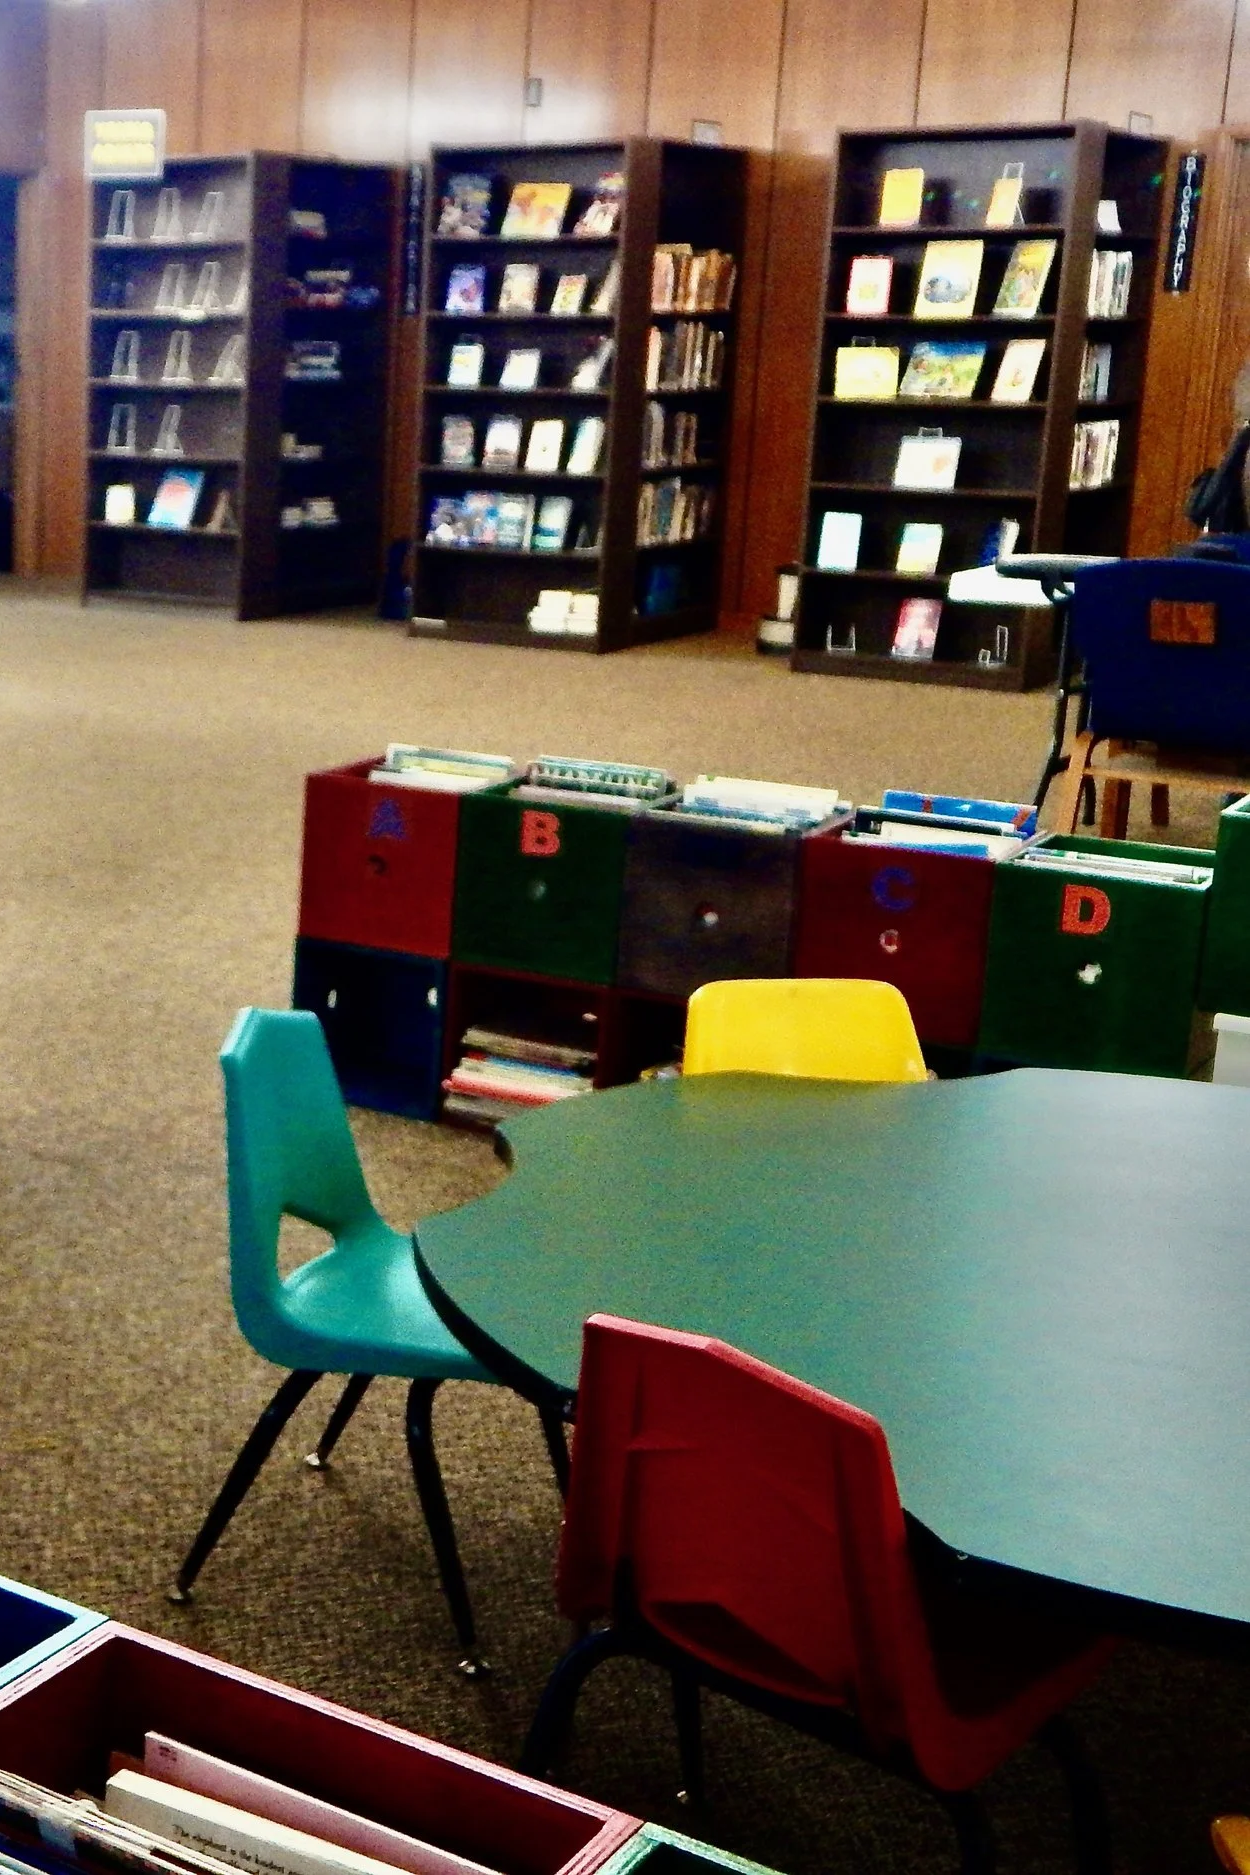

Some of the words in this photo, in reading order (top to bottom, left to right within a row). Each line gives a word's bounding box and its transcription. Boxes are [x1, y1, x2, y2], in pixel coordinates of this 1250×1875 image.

[1173, 156, 1197, 288] BIOGRAPHY
[367, 800, 406, 840] A
[522, 809, 561, 855] B
[872, 866, 915, 911] C
[1061, 884, 1111, 935] D
